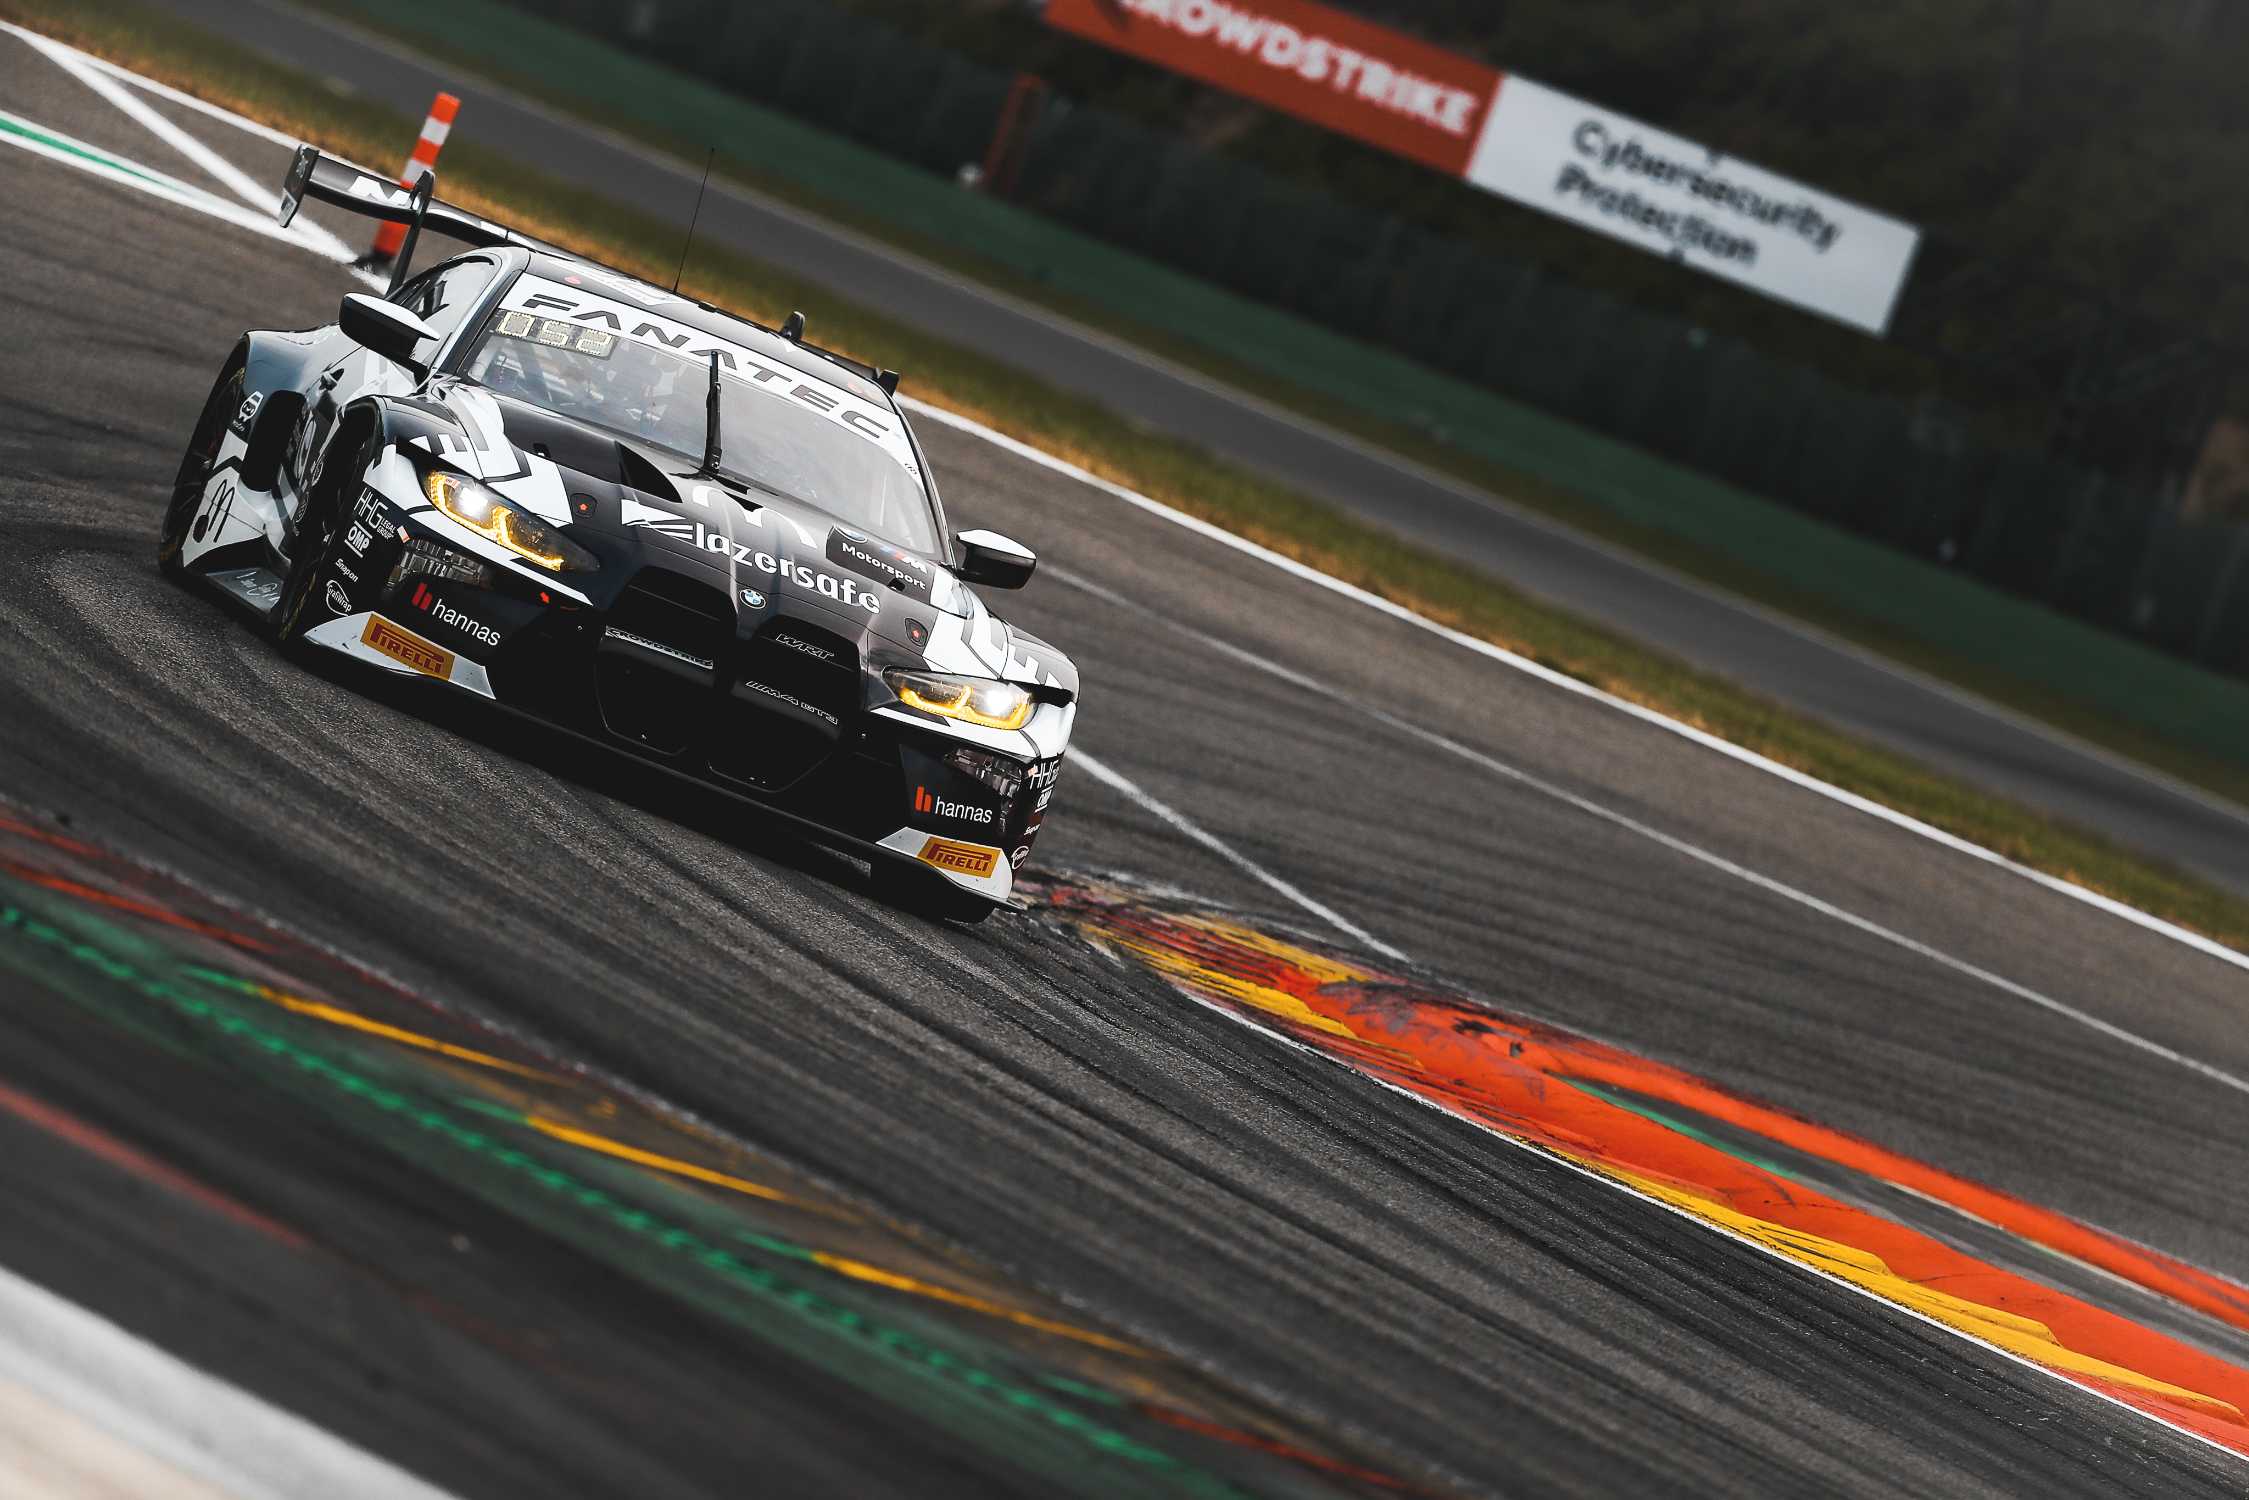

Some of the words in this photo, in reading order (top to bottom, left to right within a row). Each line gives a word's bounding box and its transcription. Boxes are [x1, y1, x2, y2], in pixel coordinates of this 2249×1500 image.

[1119, 0, 1478, 136] ROWDSTRIKE
[1573, 118, 1842, 254] Cybersecurity
[1555, 162, 1758, 268] Protection
[522, 293, 890, 440] FANATEC
[353, 487, 389, 529] HHG
[347, 525, 370, 551] OMP
[696, 522, 881, 615] lazersafe
[842, 542, 926, 590] Motorsport
[432, 598, 500, 646] hannas
[370, 622, 445, 673] PIRELLI
[935, 795, 993, 823] hannas
[926, 843, 993, 873] PIRELLI
